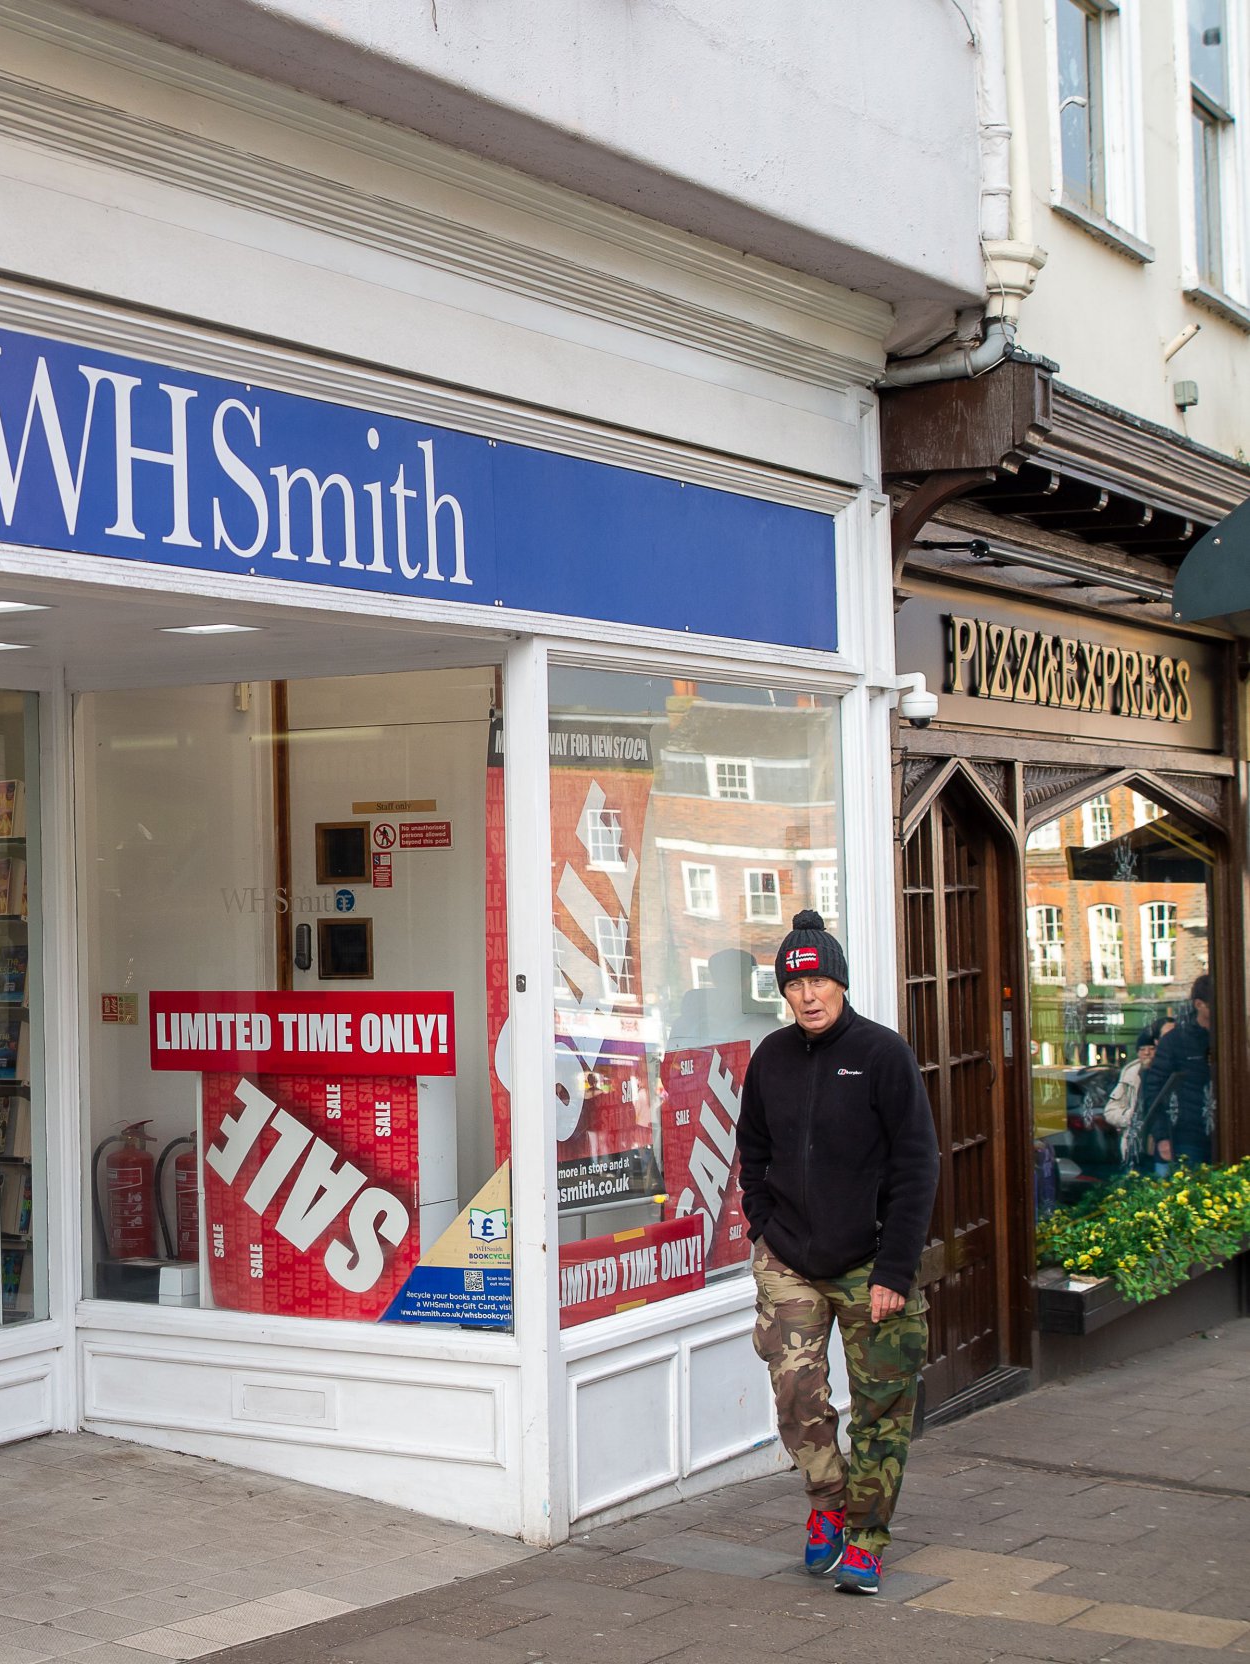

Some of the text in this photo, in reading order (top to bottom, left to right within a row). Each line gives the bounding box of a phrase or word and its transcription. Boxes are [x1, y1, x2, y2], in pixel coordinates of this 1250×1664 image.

[570, 733, 590, 757] FOR
[591, 734, 614, 759] NEW
[613, 736, 649, 761] STOCK
[376, 802, 412, 811] Staff only
[156, 1012, 448, 1054] LIMITED TIME ONLY!
[680, 1060, 694, 1076] SALE
[326, 1084, 341, 1119] SALE
[375, 1101, 390, 1137] SALE
[675, 1109, 690, 1126] SALE
[558, 1156, 630, 1178] more in store and at
[205, 1077, 409, 1293] SALE
[213, 1223, 224, 1258] SALE
[729, 1224, 742, 1240] SALE
[250, 1243, 263, 1279] SALE
[620, 1246, 658, 1291] TIME
[661, 1235, 702, 1281] ONLY!
[406, 1291, 431, 1299] Recycle
[422, 1301, 454, 1309] WHSmith
[477, 1303, 498, 1311] Card,
